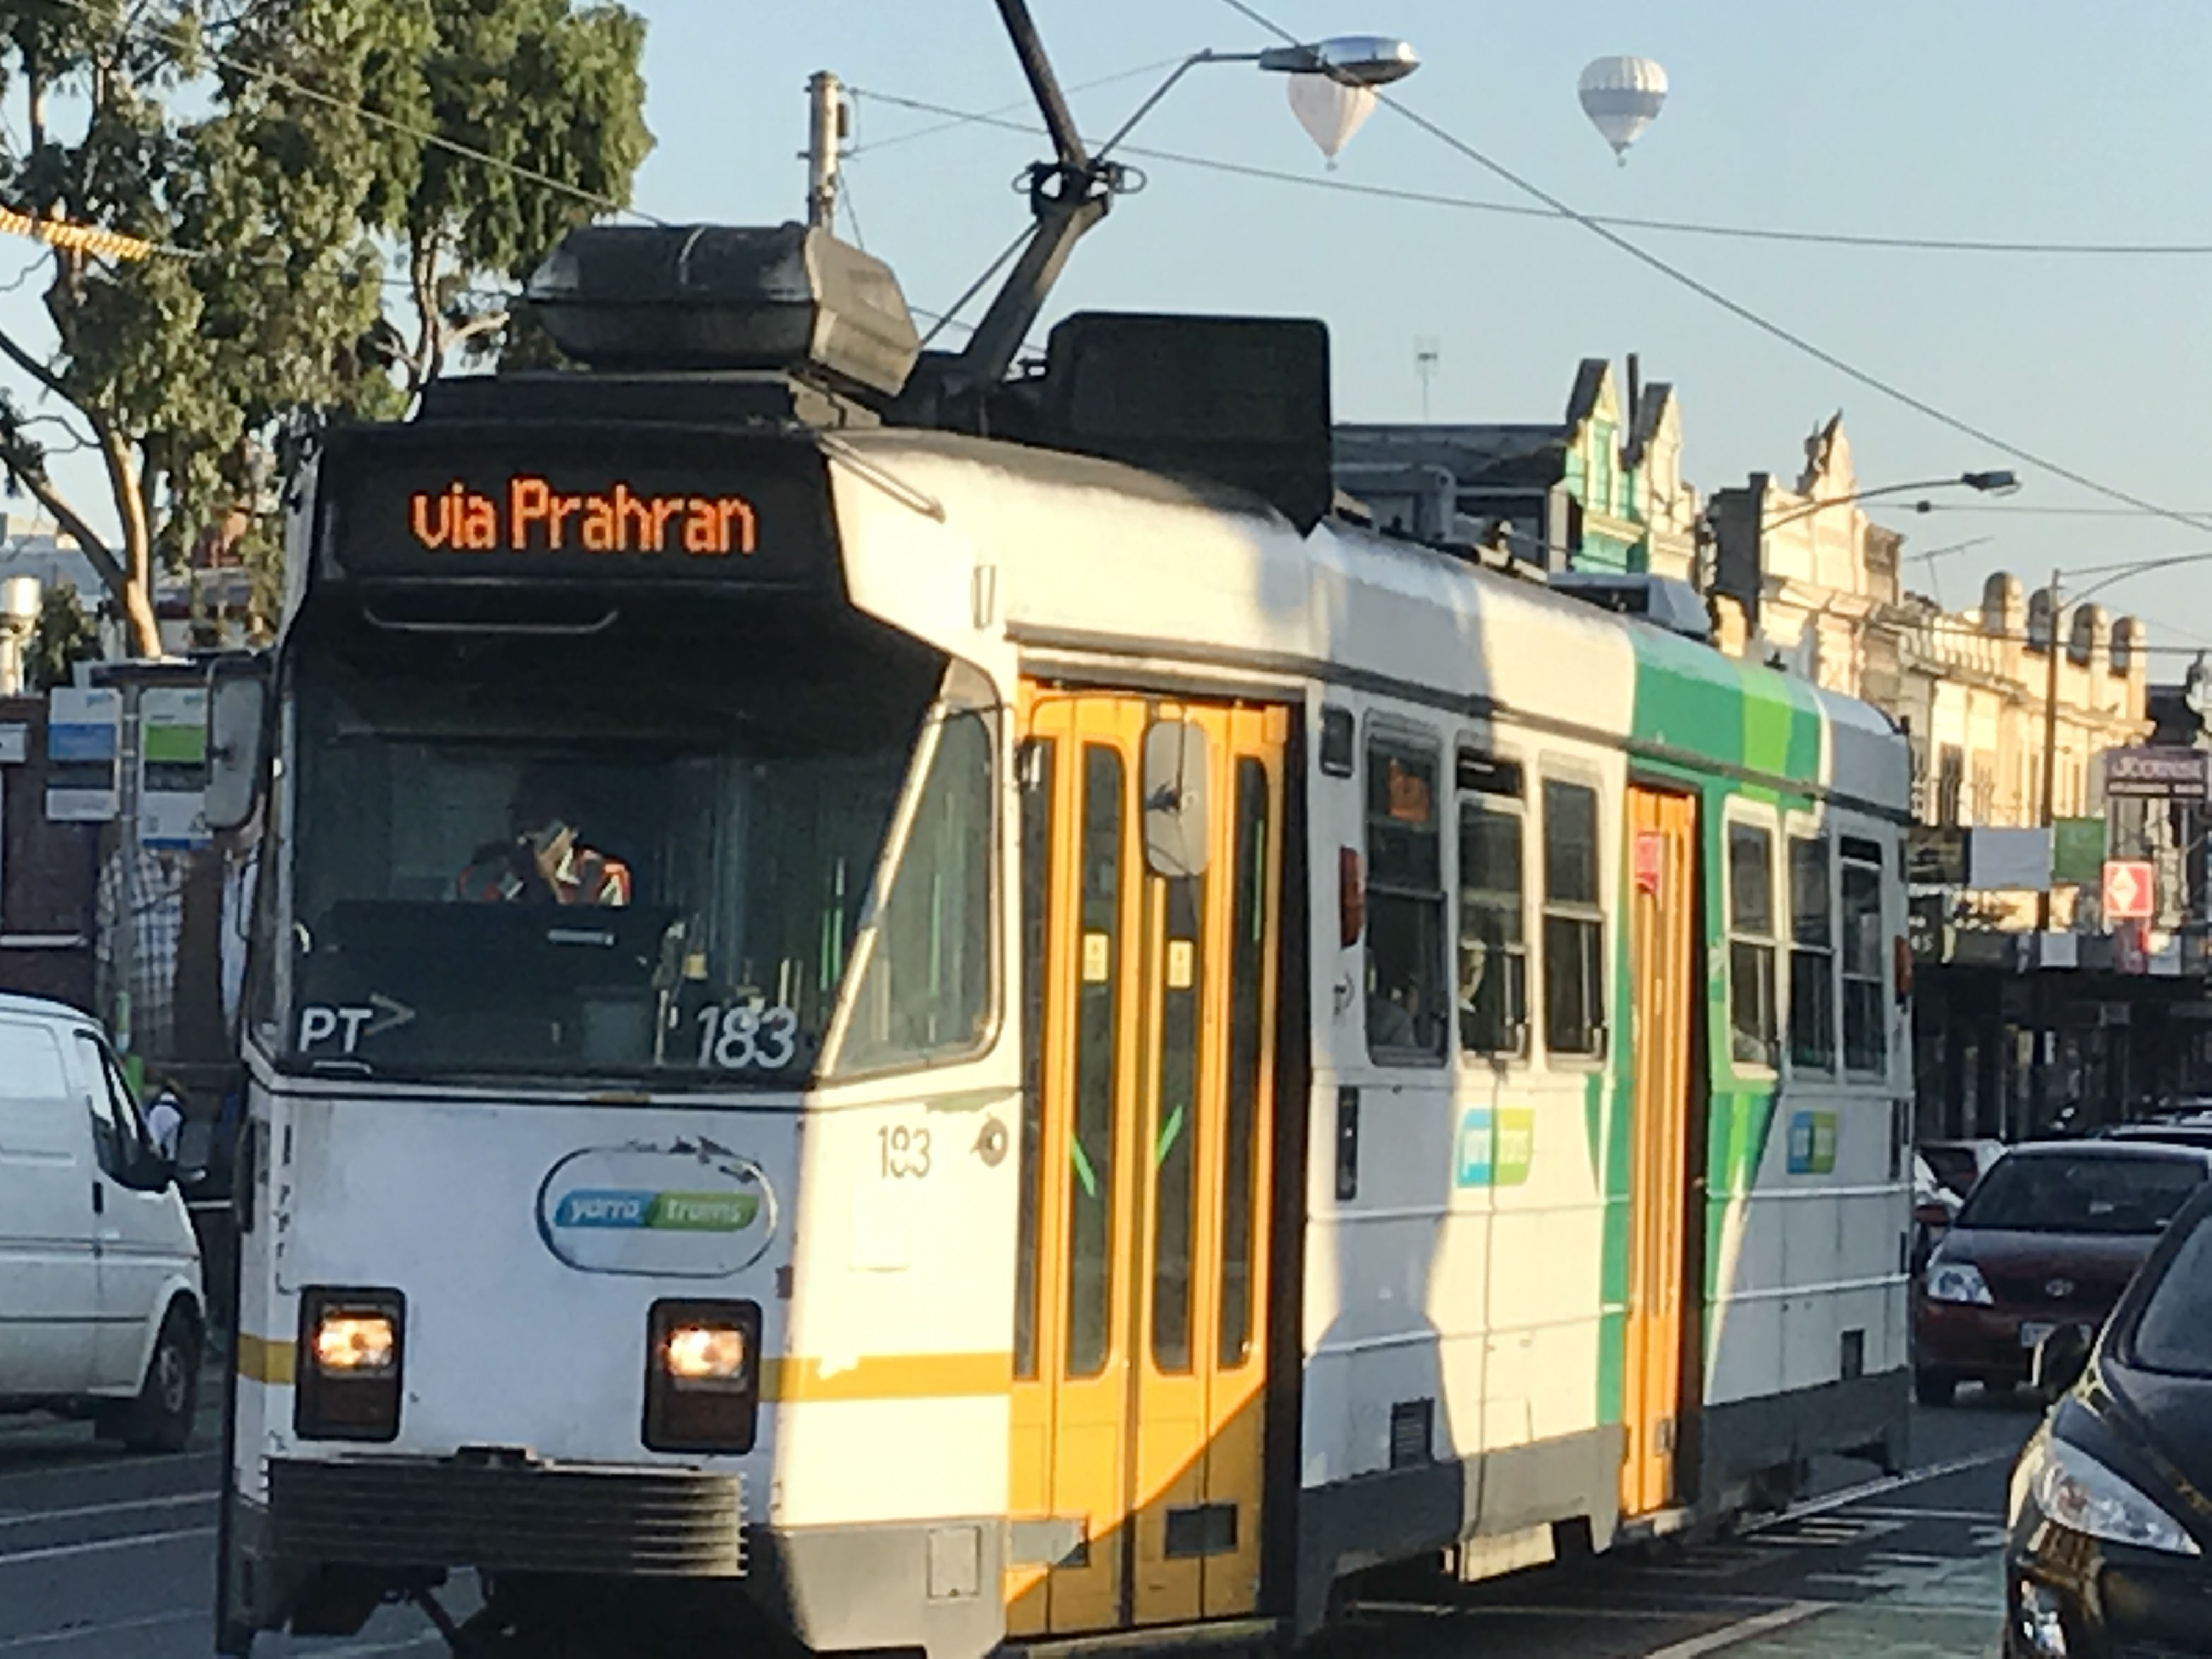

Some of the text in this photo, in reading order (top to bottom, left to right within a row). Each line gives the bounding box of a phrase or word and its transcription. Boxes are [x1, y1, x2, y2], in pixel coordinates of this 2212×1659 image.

[412, 478, 755, 554] via Prahran
[698, 1006, 798, 1068] 183
